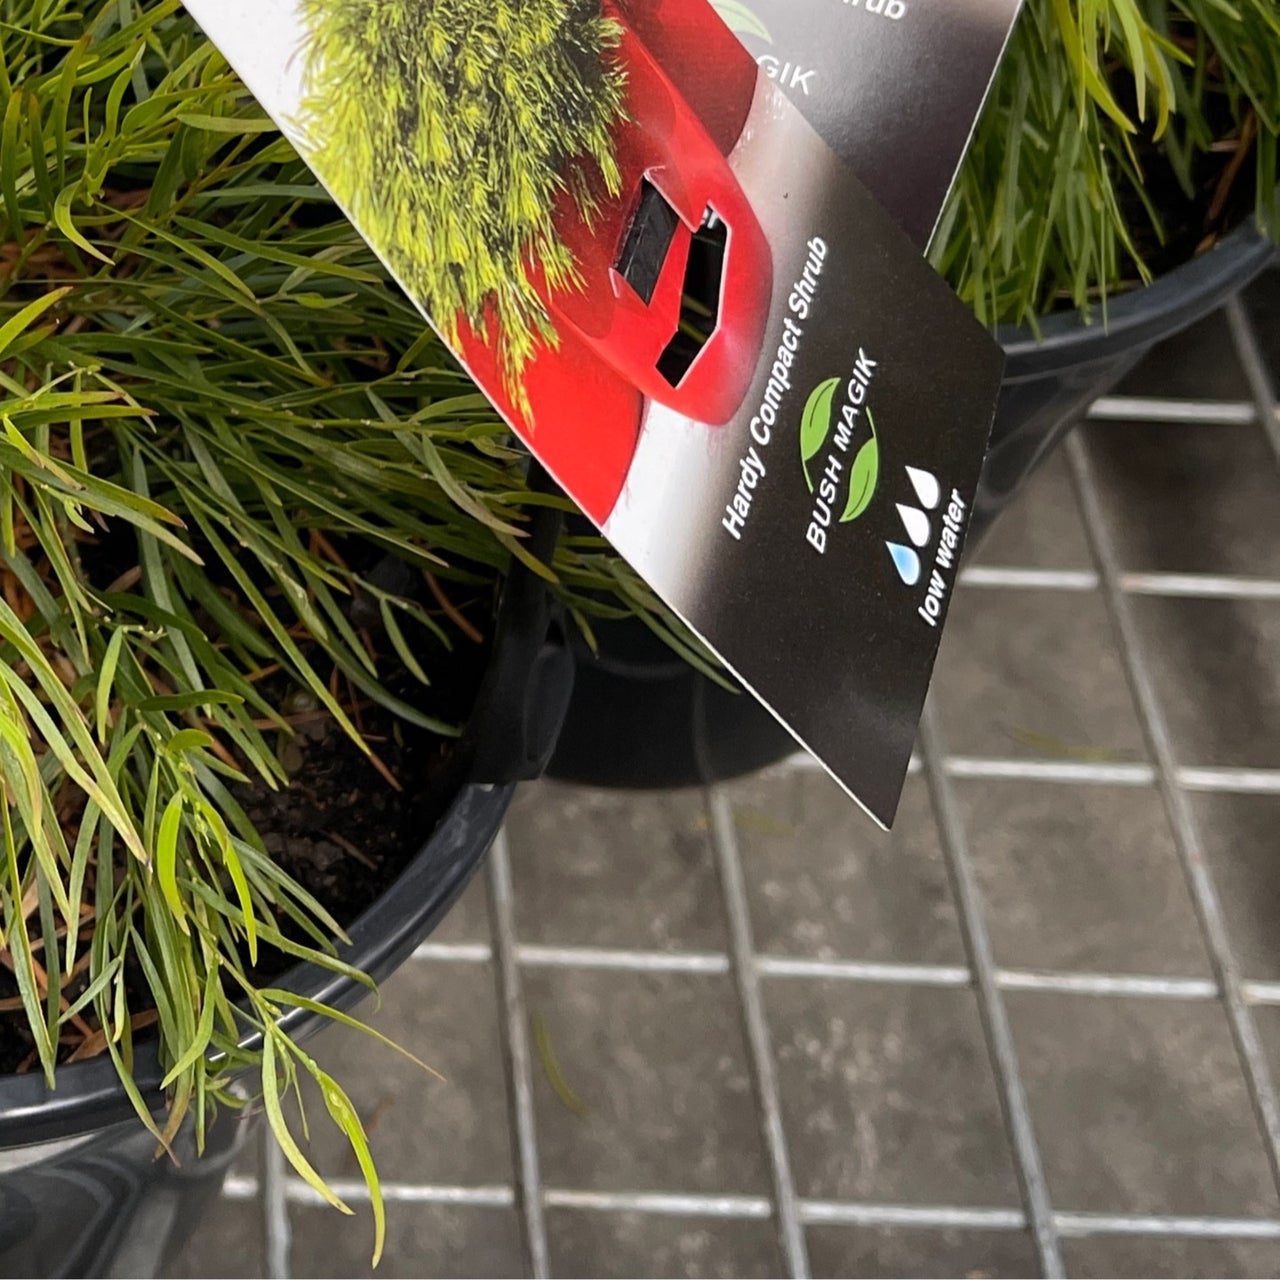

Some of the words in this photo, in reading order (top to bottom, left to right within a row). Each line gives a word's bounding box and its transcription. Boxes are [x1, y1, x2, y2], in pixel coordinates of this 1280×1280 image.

[756, 54, 816, 97] GIK
[722, 448, 767, 541] Hardy
[749, 318, 802, 446] Compact
[789, 235, 828, 321] Shrub
[806, 455, 844, 555] BUSH
[834, 347, 879, 452] MAGIK
[918, 571, 950, 628] low
[935, 488, 968, 581] water
